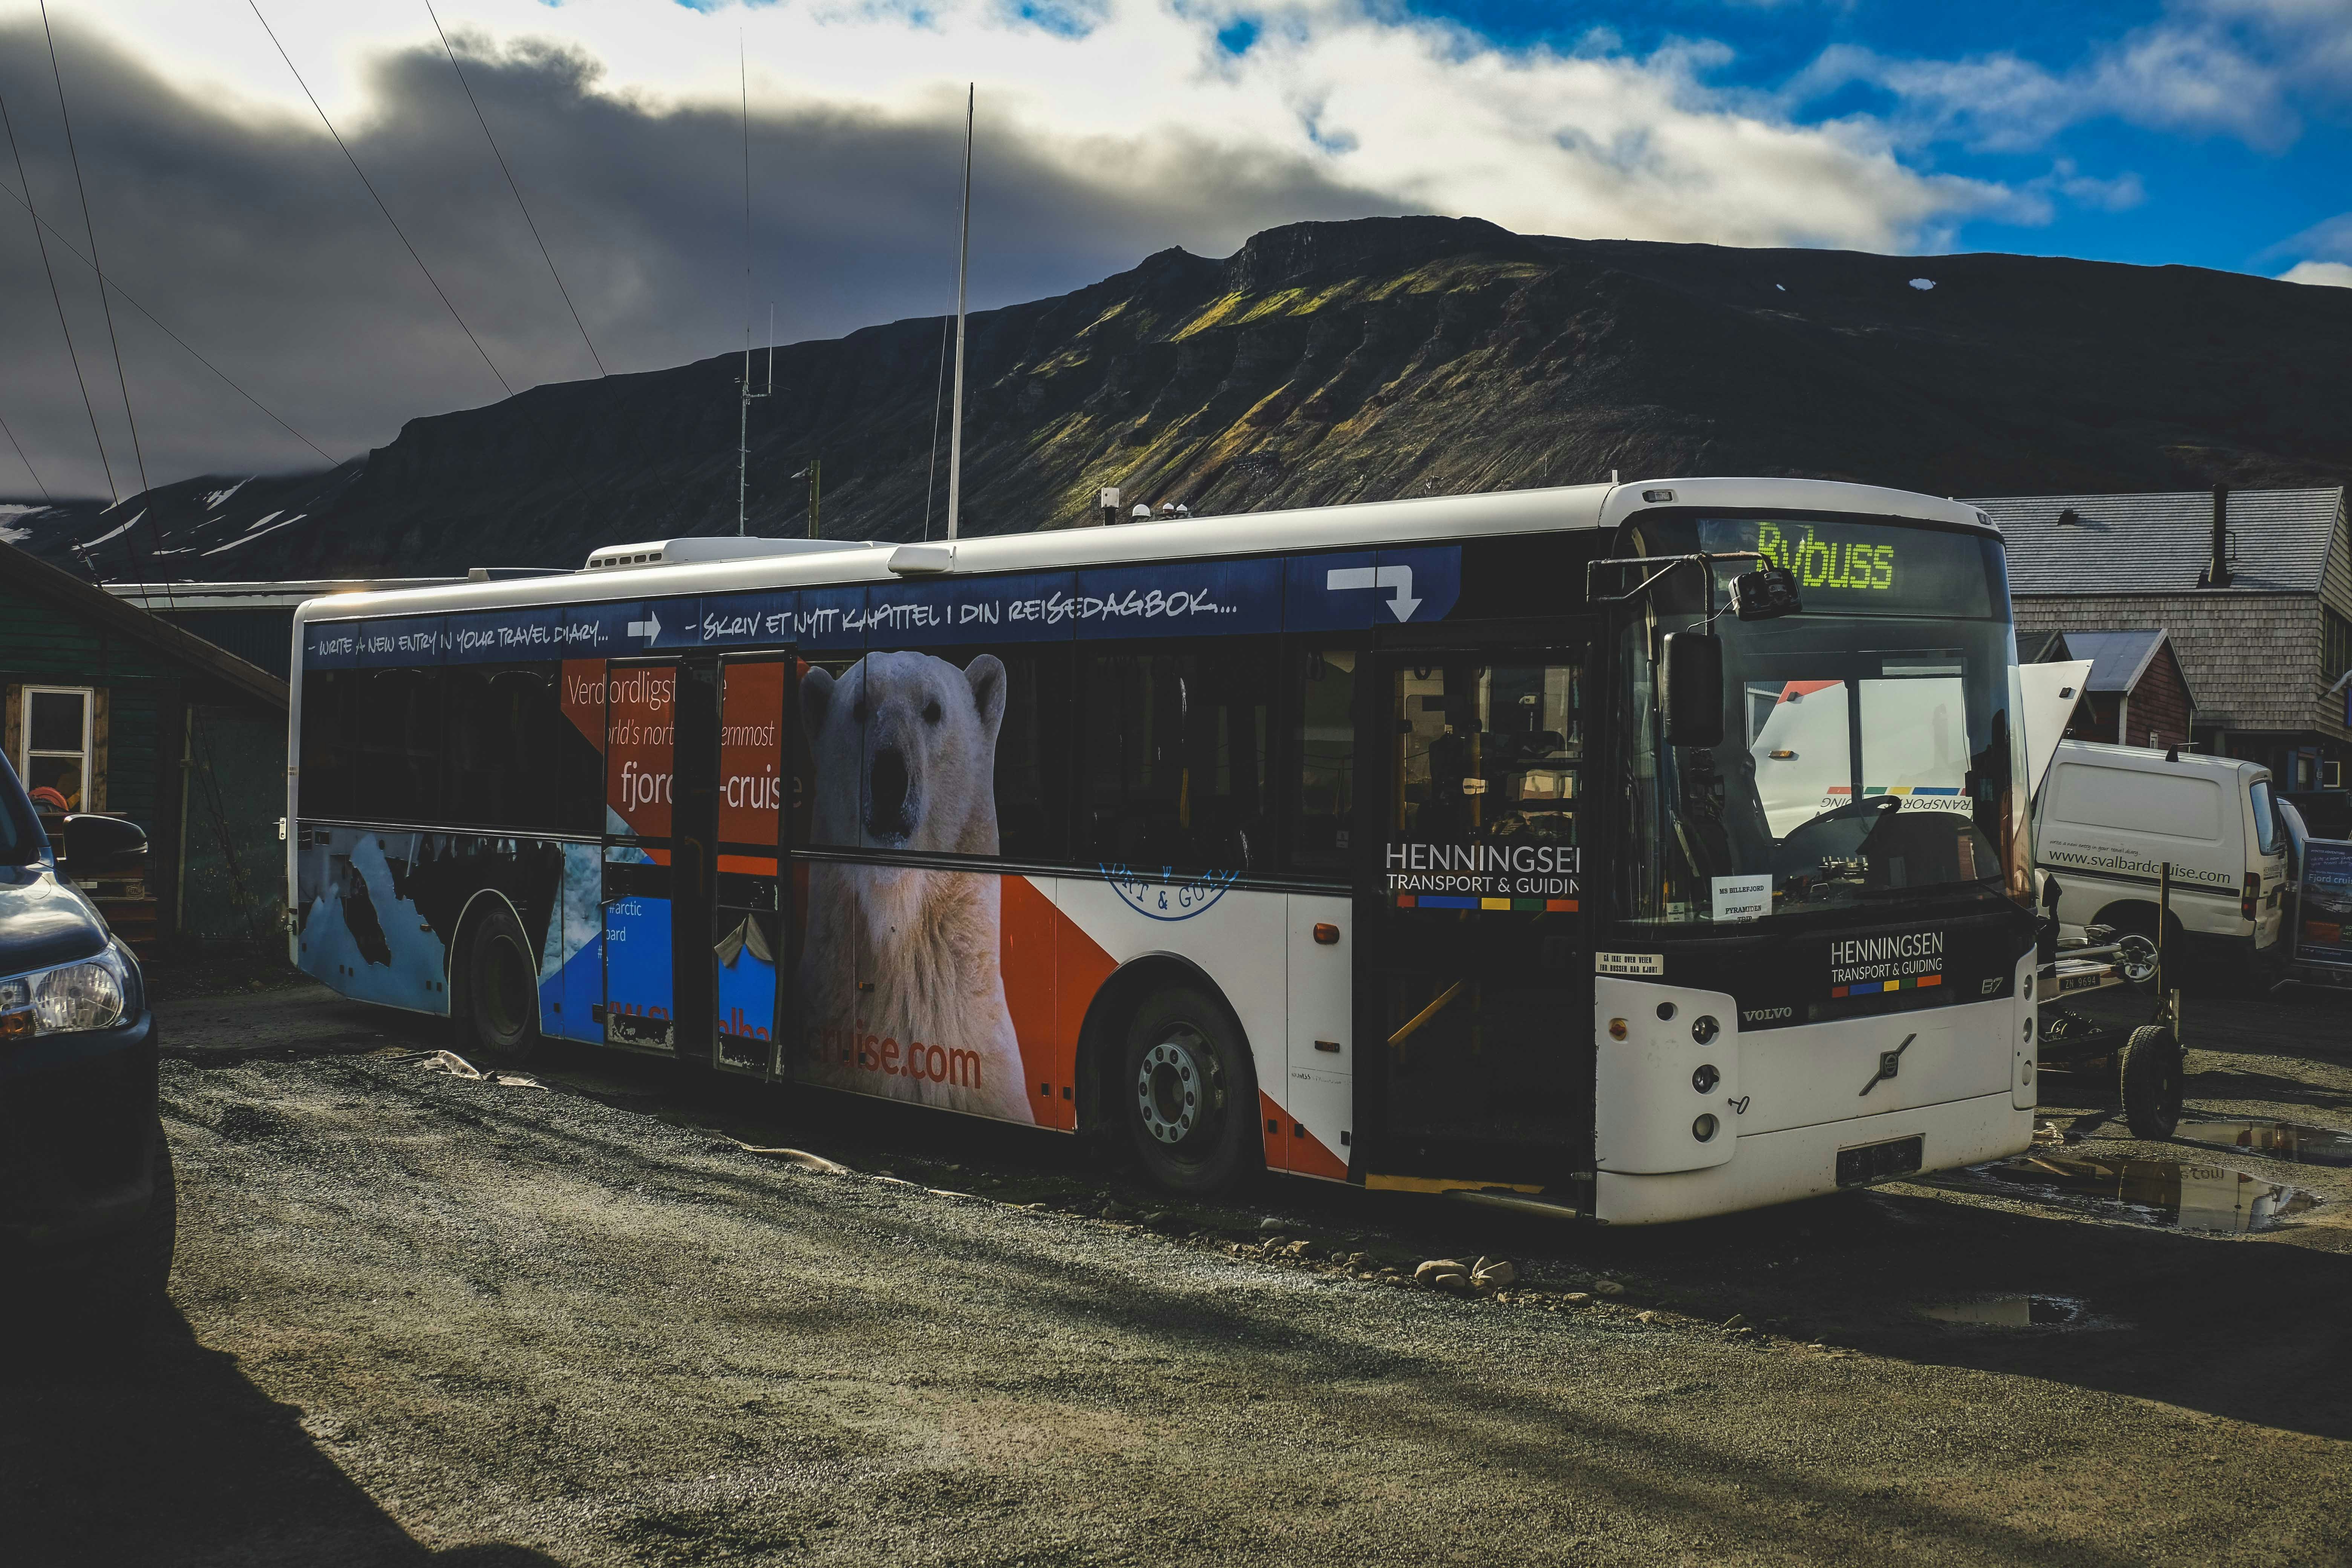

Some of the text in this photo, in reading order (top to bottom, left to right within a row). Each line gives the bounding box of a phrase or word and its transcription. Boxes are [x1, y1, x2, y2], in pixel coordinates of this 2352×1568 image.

[703, 612, 760, 640] SKRIV
[766, 612, 791, 634] ET
[794, 608, 840, 638] NYTT
[842, 603, 940, 632] KAPITTEL
[947, 605, 951, 624] I
[960, 600, 999, 625] DIN
[319, 638, 353, 655] WRITE
[356, 637, 366, 655] A
[368, 637, 395, 653] NEW
[398, 631, 436, 655] ENTRY
[441, 632, 452, 649] IN
[457, 629, 495, 654] YOUR
[498, 624, 550, 647] TRAVEL
[1386, 843, 1580, 873] HENNINGSE
[1386, 874, 1493, 892] TRANSPORT
[1498, 877, 1511, 893] &
[2309, 873, 2332, 883] Fjord
[1729, 885, 1764, 894] BILLEFJORD
[609, 900, 642, 916] #arctic
[1725, 905, 1762, 915] PYRAMIDEN
[1831, 932, 1943, 965] HENNINGSEN
[1831, 957, 1943, 983] TRANSPORT & GUIDING
[2065, 976, 2096, 989] ZN 9694
[1743, 1007, 1792, 1022] VOLVO
